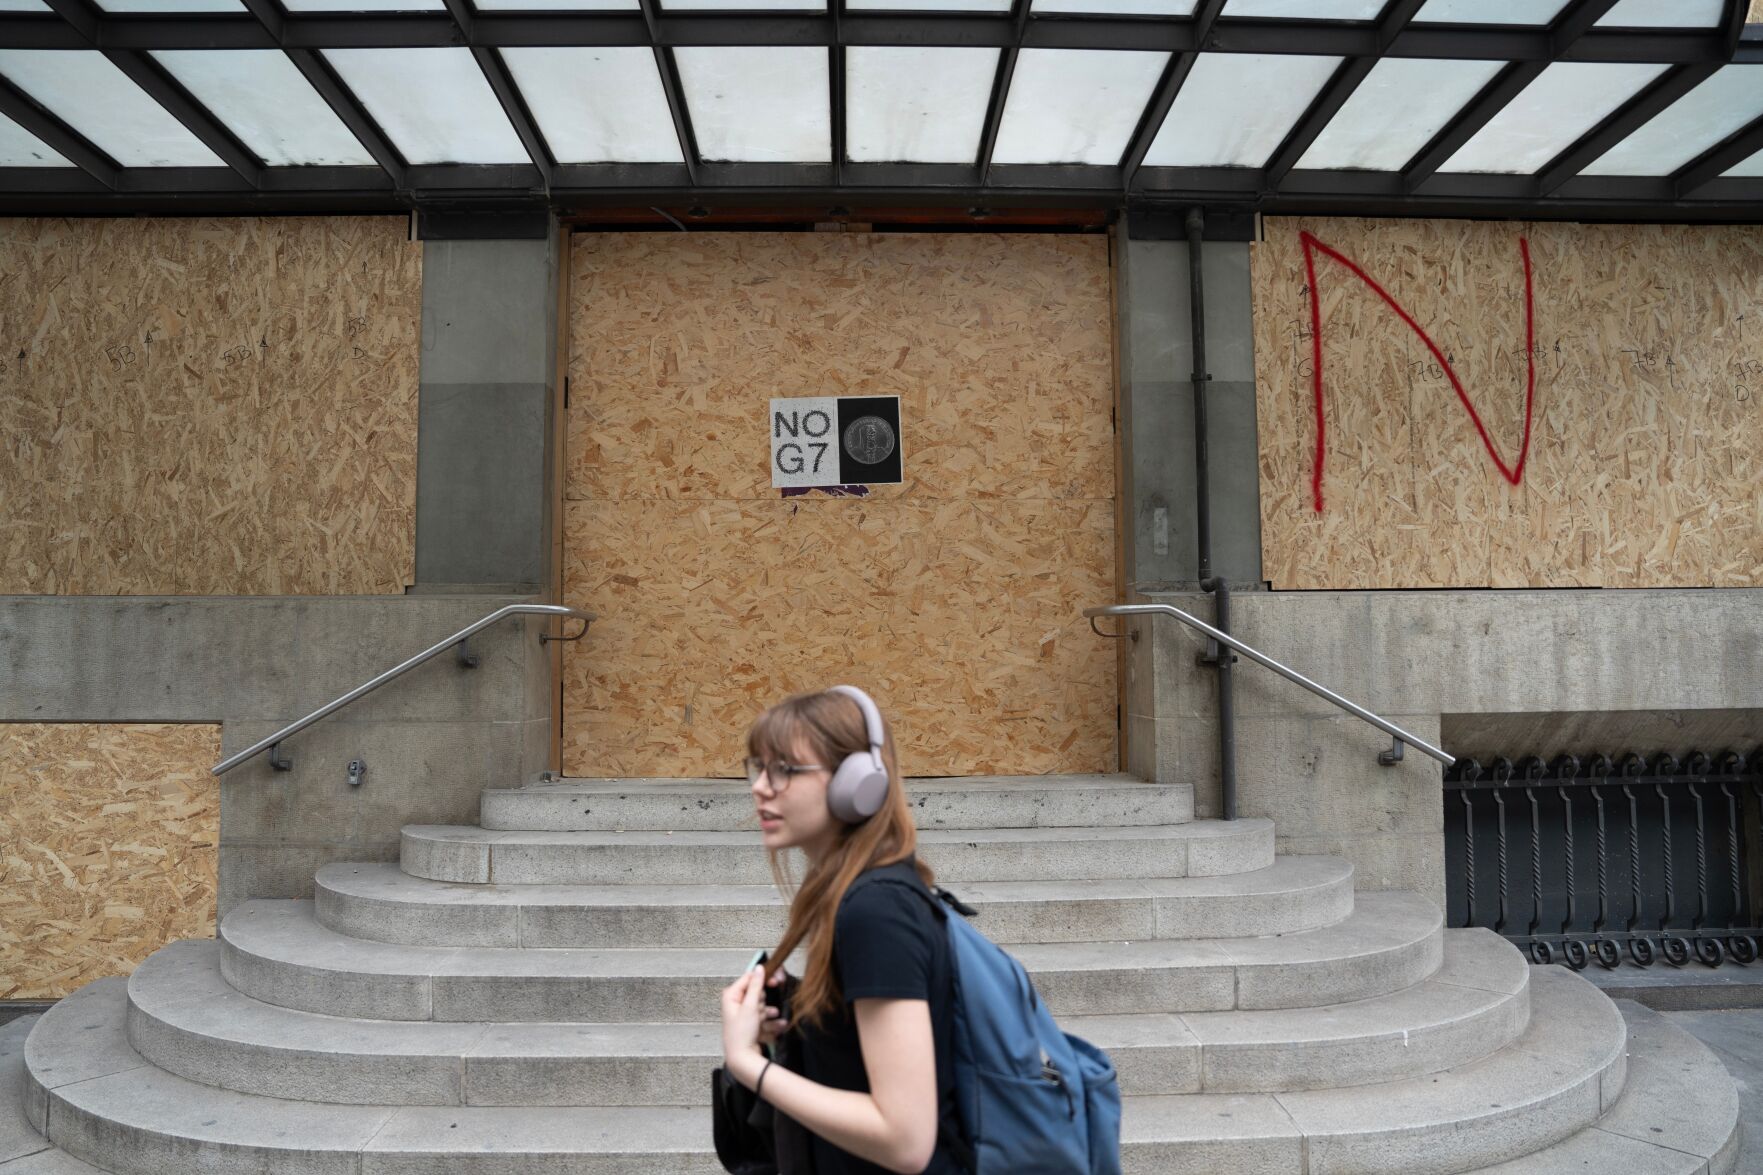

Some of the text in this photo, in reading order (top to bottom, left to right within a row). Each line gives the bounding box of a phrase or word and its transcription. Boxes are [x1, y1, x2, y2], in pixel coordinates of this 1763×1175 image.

[105, 345, 136, 372] 5B
[222, 345, 251, 366] 5B
[1300, 230, 1533, 512] N
[1409, 360, 1443, 382] 7B
[1734, 385, 1750, 401] D
[774, 409, 831, 438] NO
[776, 442, 829, 475] G7
